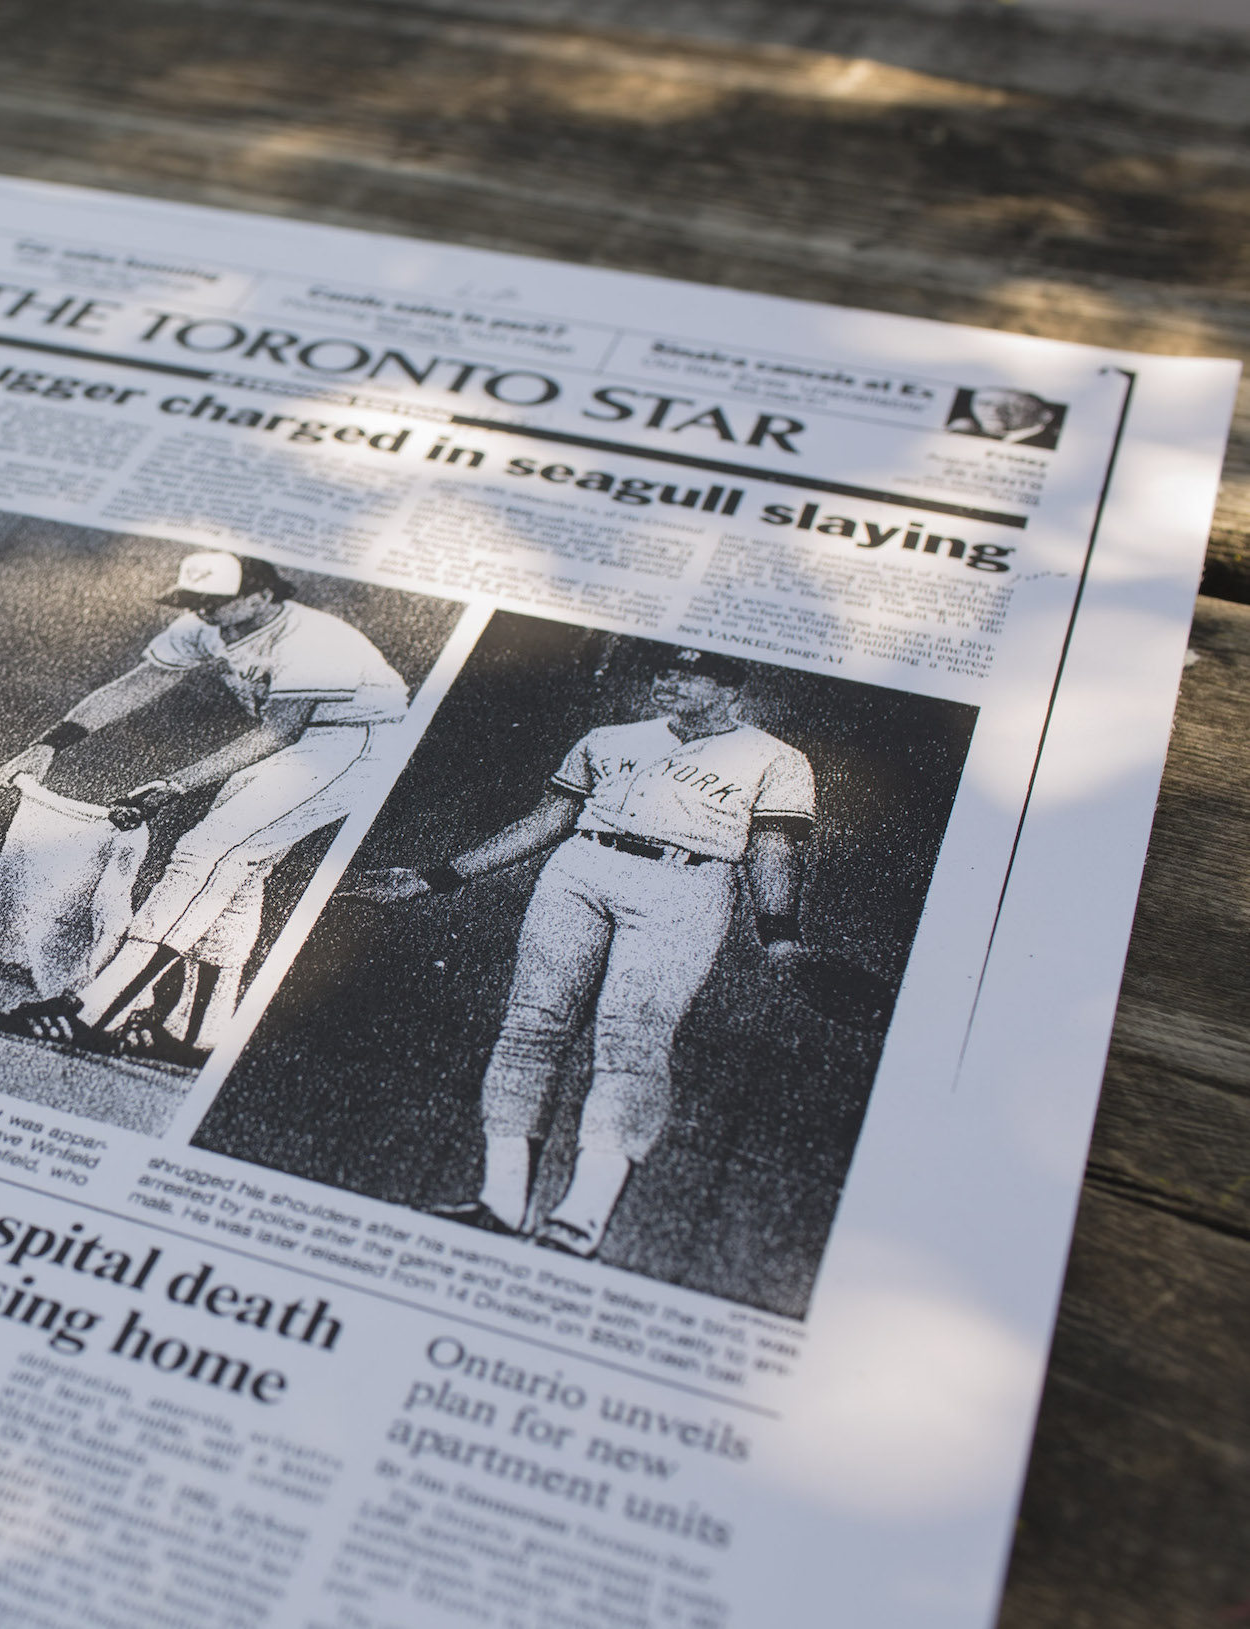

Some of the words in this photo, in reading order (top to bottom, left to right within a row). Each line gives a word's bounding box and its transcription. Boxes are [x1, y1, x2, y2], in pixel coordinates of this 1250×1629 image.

[142, 313, 560, 406] TORONTO
[583, 386, 804, 454] STAR
[159, 394, 410, 452] charged
[425, 436, 485, 468] in
[508, 458, 743, 516] seagull
[762, 502, 1014, 573] slaying
[661, 759, 742, 803] YORK
[9, 1115, 44, 1134] was
[48, 1127, 107, 1149] appar-
[30, 1138, 100, 1169] Winfield
[50, 1167, 89, 1187] who
[166, 1264, 341, 1350] death
[110, 1310, 286, 1403] home
[426, 1337, 586, 1409] Ontario
[600, 1397, 748, 1461] unveils
[403, 1379, 497, 1427] plan
[510, 1404, 574, 1450] for
[585, 1437, 677, 1480] new
[388, 1420, 610, 1509] apartment
[623, 1494, 731, 1549] units
